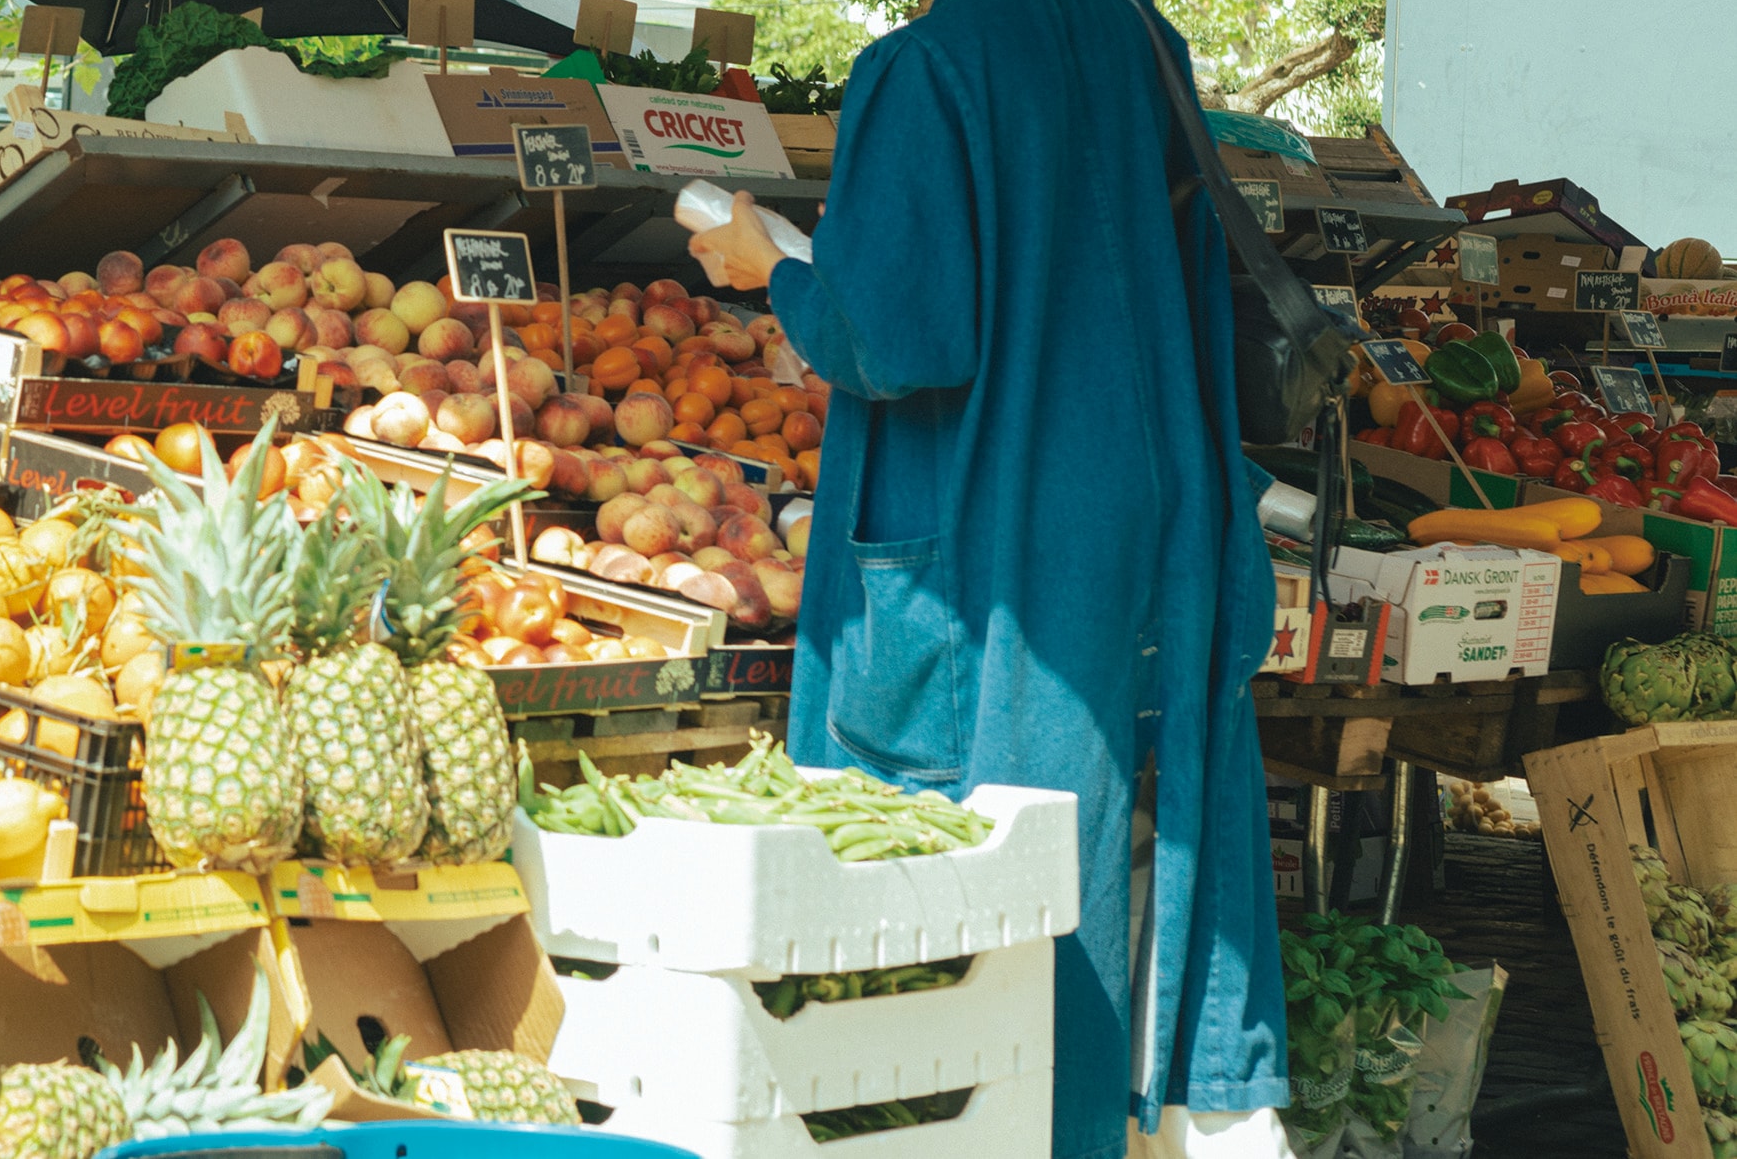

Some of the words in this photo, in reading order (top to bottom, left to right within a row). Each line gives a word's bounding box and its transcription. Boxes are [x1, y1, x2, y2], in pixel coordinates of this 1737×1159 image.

[649, 95, 675, 106] calidad
[644, 109, 745, 147] CRICKET
[44, 382, 154, 421] Level
[152, 388, 255, 425] fruit
[8, 457, 71, 496] Level
[1444, 569, 1481, 585] DANSK
[1484, 568, 1520, 585] GRØNT
[549, 665, 650, 710] fruit
[1587, 843, 1611, 912] Défendons
[1605, 915, 1616, 930] le
[1608, 933, 1625, 964] goût
[1619, 966, 1631, 985] du
[1625, 987, 1641, 1021] frais
